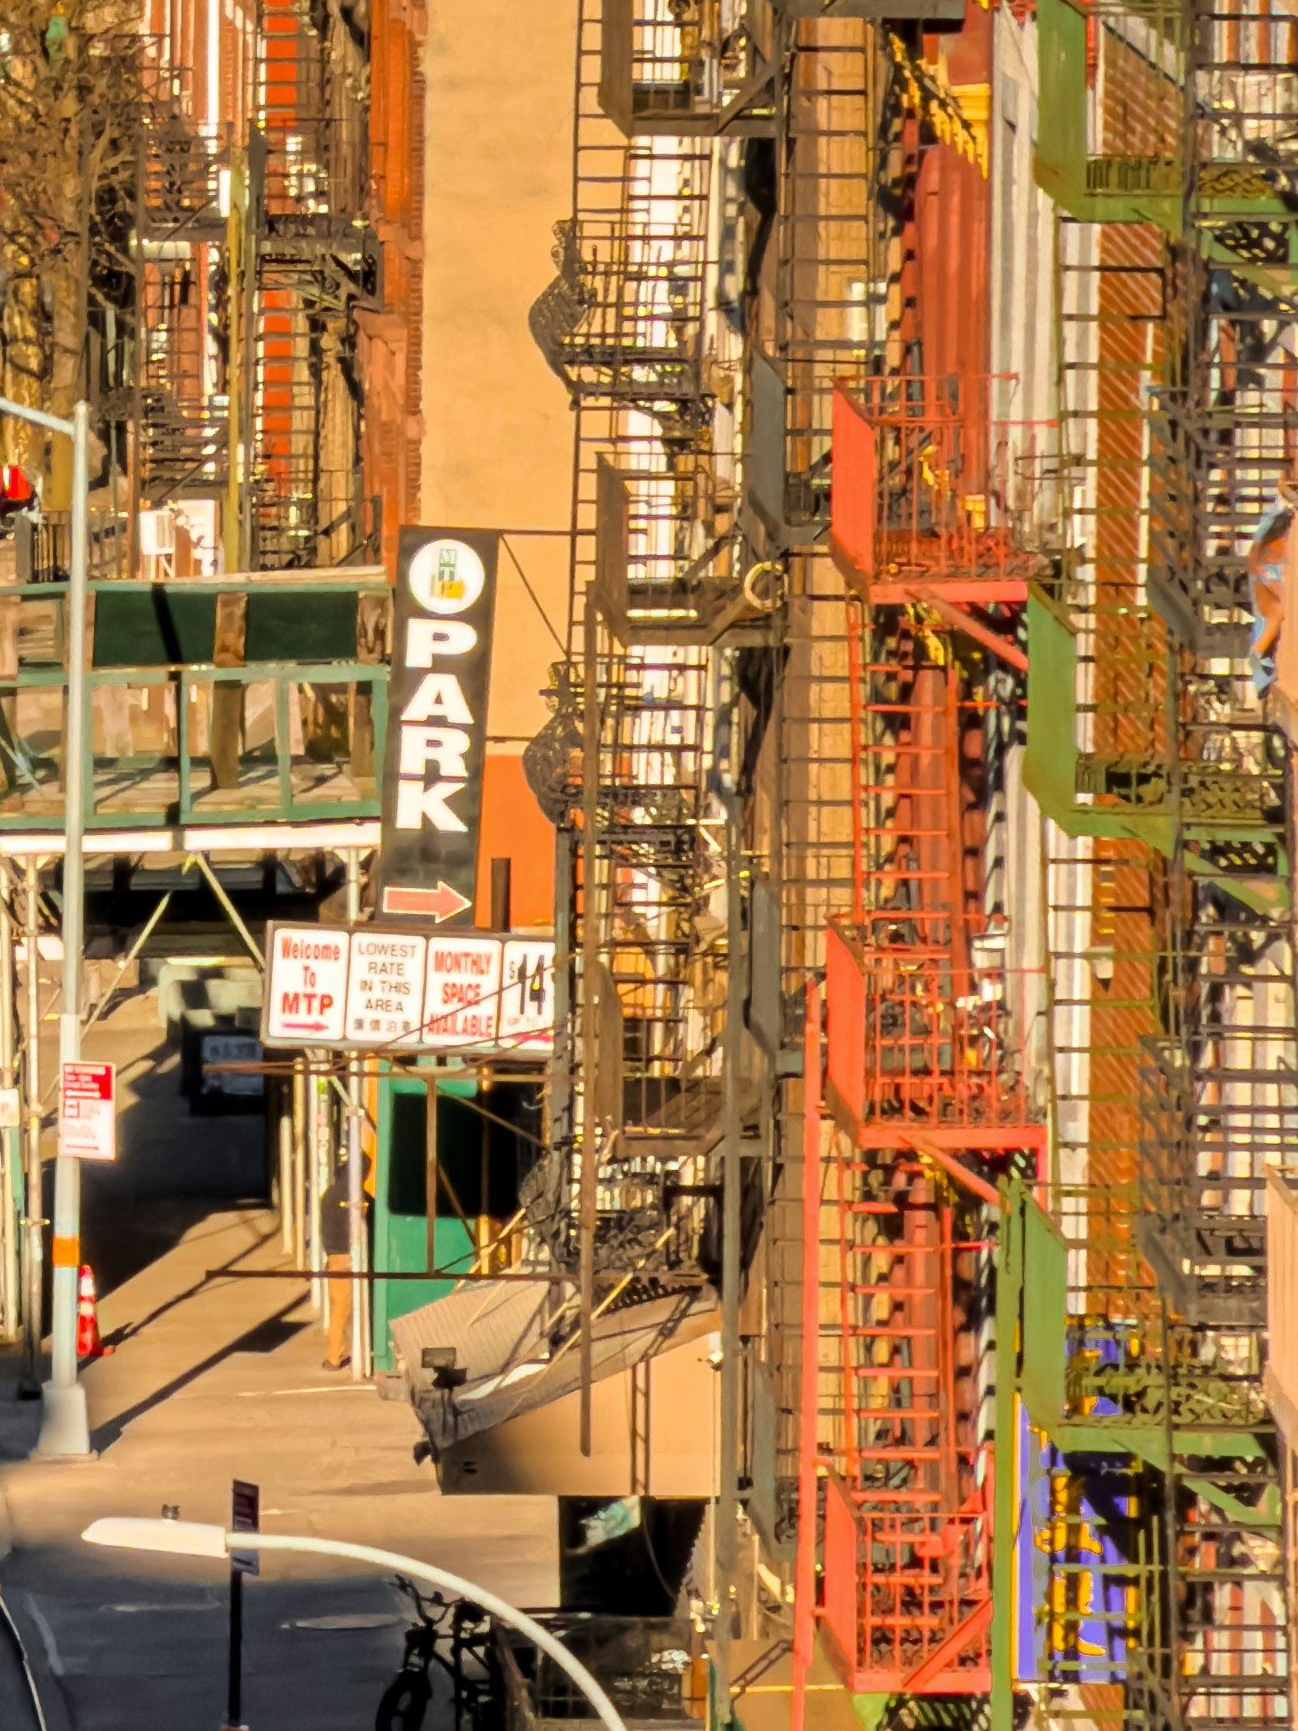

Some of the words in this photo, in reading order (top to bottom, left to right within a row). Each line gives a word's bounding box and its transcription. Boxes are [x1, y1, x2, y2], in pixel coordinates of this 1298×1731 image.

[396, 618, 478, 832] PARK
[281, 936, 341, 961] Welcome
[357, 941, 418, 959] LOWEST
[367, 961, 405, 977] RATE
[434, 951, 493, 976] MONTHLY
[302, 965, 317, 989] To
[359, 980, 374, 993] IN
[380, 981, 412, 996] THIS
[281, 992, 334, 1016] MTP
[364, 998, 404, 1013] AREA
[441, 982, 482, 1005] SPACE
[427, 1014, 494, 1039] AVAILABLE
